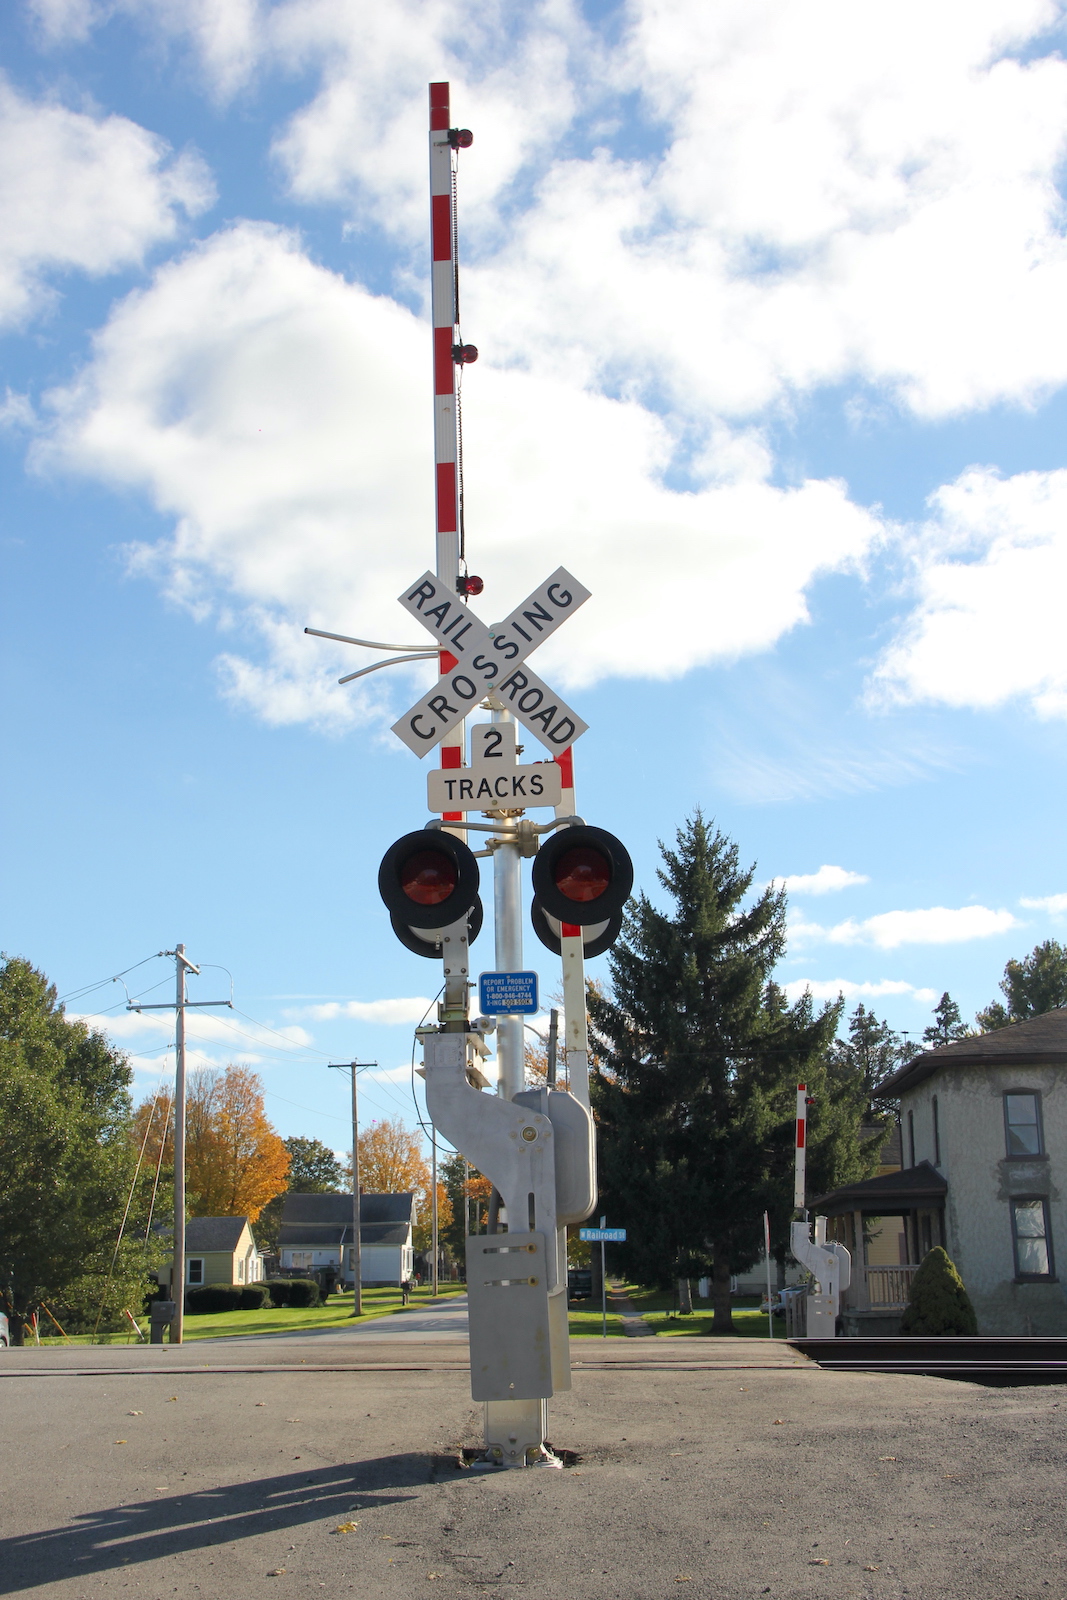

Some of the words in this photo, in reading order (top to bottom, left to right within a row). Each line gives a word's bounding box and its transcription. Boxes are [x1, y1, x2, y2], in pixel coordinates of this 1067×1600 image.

[408, 580, 473, 652] RAIL
[499, 670, 575, 744] ROAD
[410, 583, 573, 740] CROSSING
[483, 730, 503, 758] 2
[444, 774, 544, 800] TRACKS
[586, 1230, 618, 1239] Railroad
